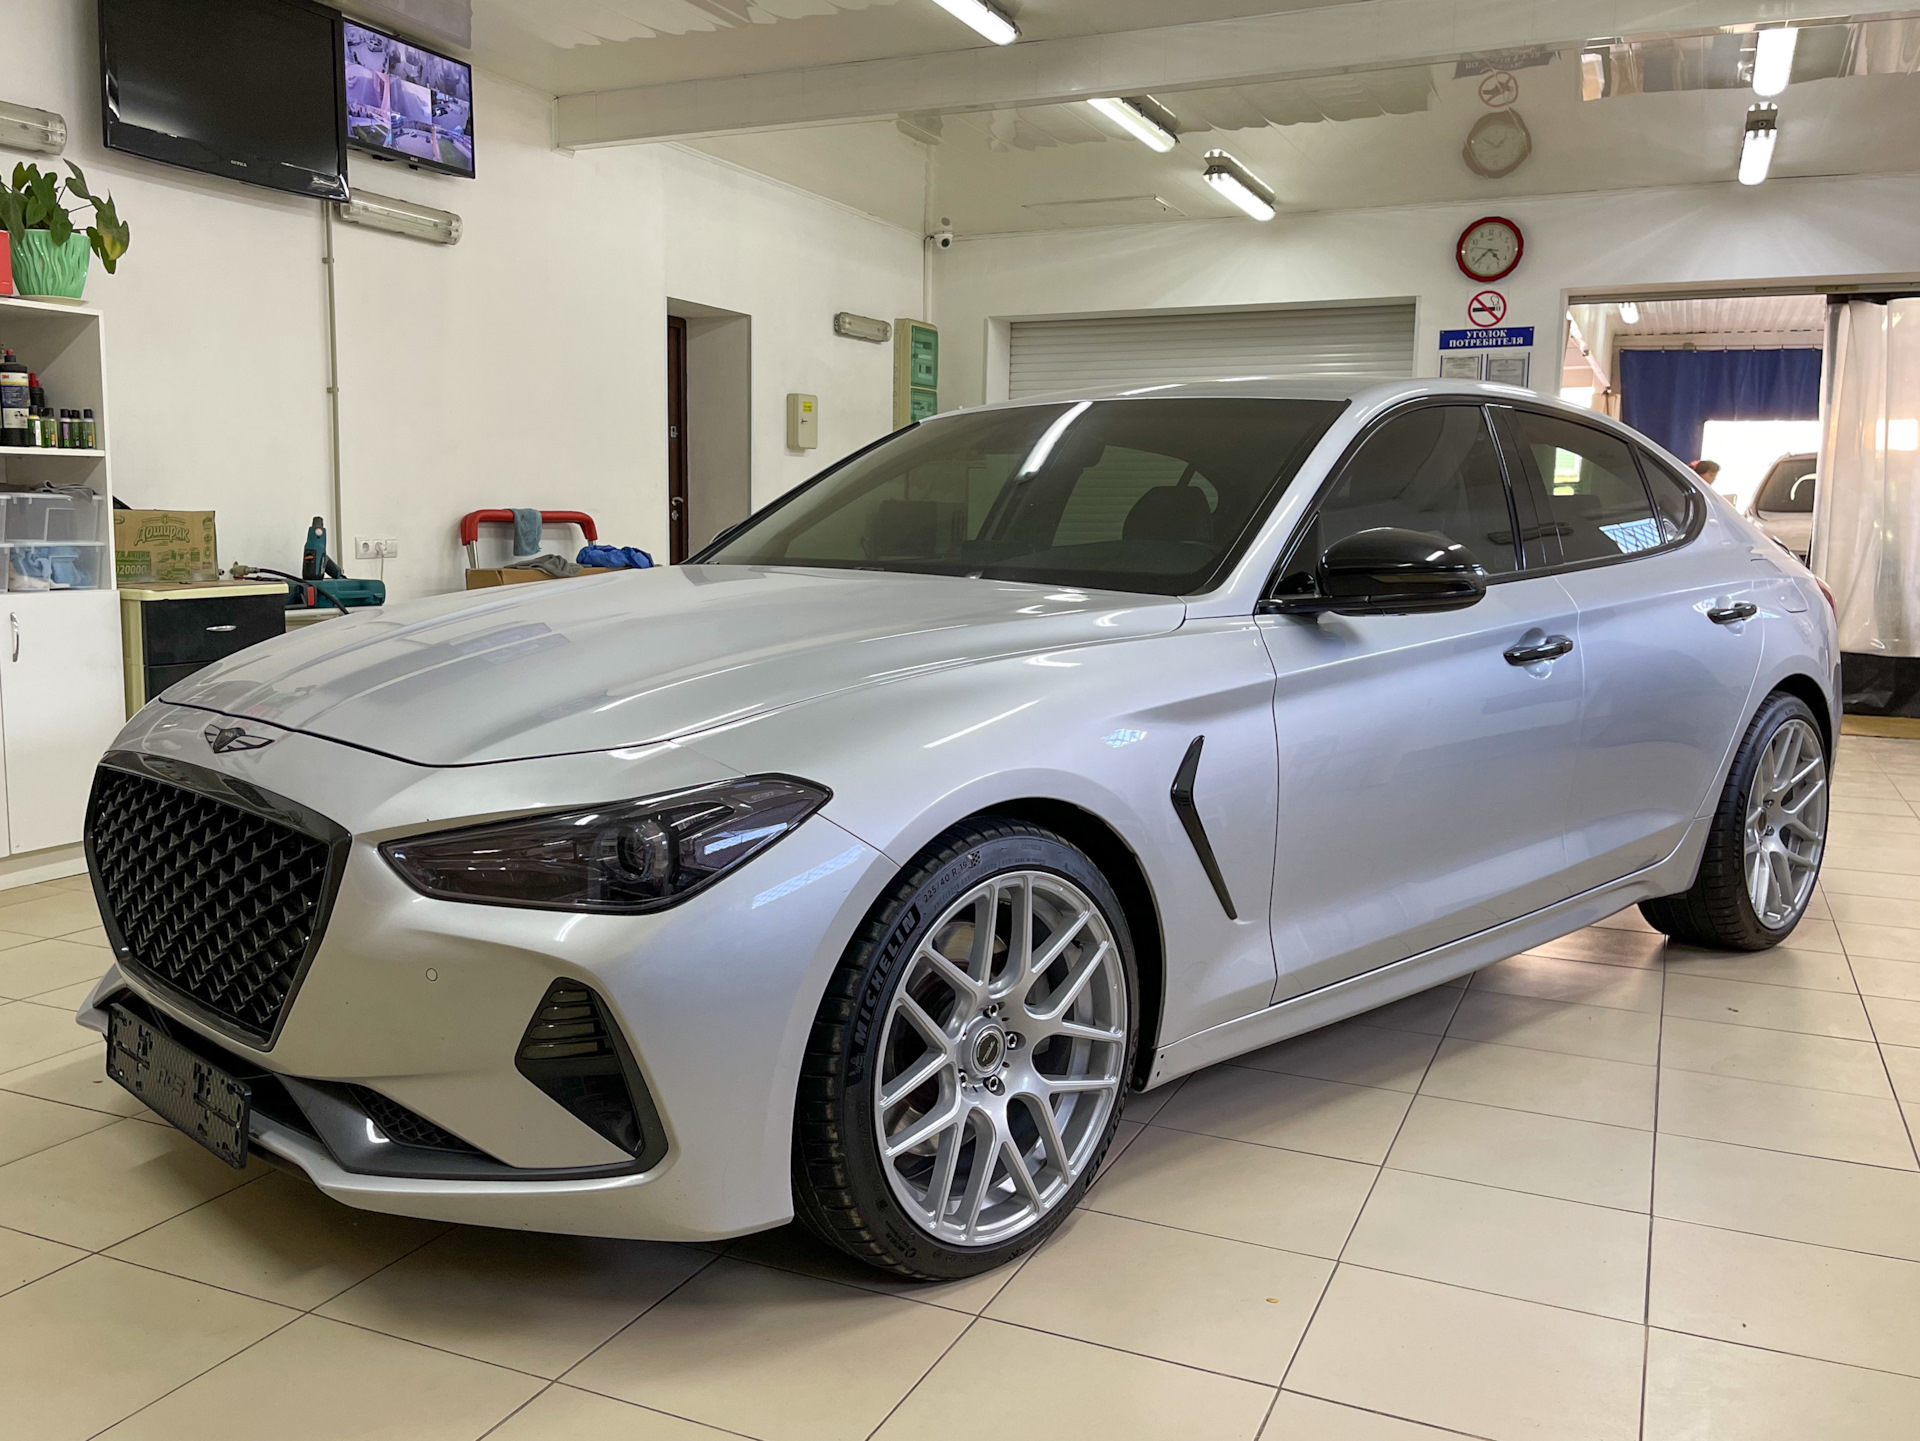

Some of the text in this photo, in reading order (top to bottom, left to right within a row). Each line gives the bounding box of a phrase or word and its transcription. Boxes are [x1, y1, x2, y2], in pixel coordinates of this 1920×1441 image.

[1449, 336, 1523, 348] ПОТРЕБИТЕЛЯ
[1466, 329, 1507, 339] УГОЛОК
[923, 873, 950, 903] 225/40
[959, 861, 968, 871] 19
[854, 910, 917, 1047] MICHELIN
